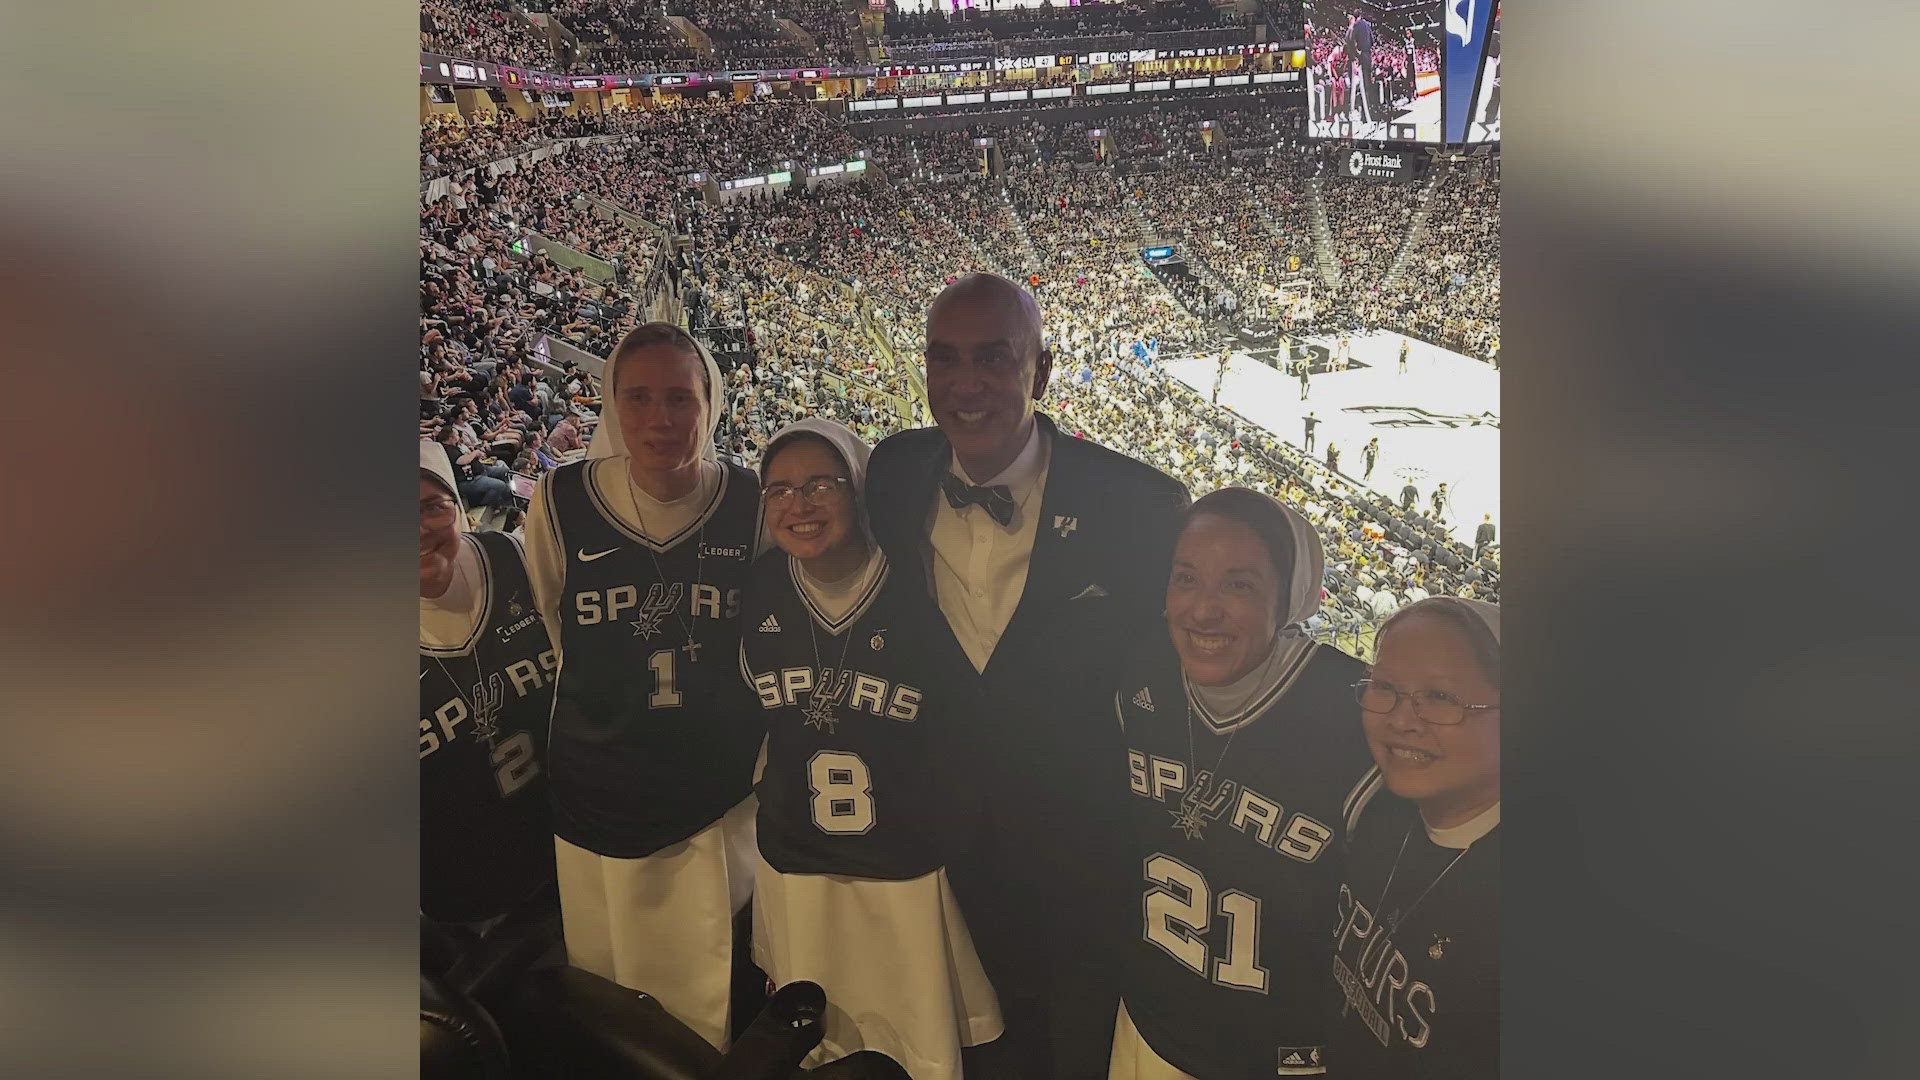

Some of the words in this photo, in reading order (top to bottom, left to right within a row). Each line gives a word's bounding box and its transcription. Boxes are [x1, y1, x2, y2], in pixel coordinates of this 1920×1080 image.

[1021, 57, 1036, 68] SA
[1109, 51, 1129, 62] OKC
[1364, 153, 1382, 167] Frost
[1382, 154, 1402, 169] Bank
[1367, 168, 1395, 178] CENTER
[704, 546, 741, 557] LEDGER
[504, 615, 536, 636] LEDGER
[758, 625, 781, 633] adidas
[648, 649, 682, 709] 1
[754, 667, 923, 730] SPURS
[490, 729, 540, 798] 2
[806, 749, 877, 836] 8
[1128, 748, 1334, 863] SPURS
[1142, 852, 1270, 995] 21
[1333, 883, 1436, 1048] SPURS
